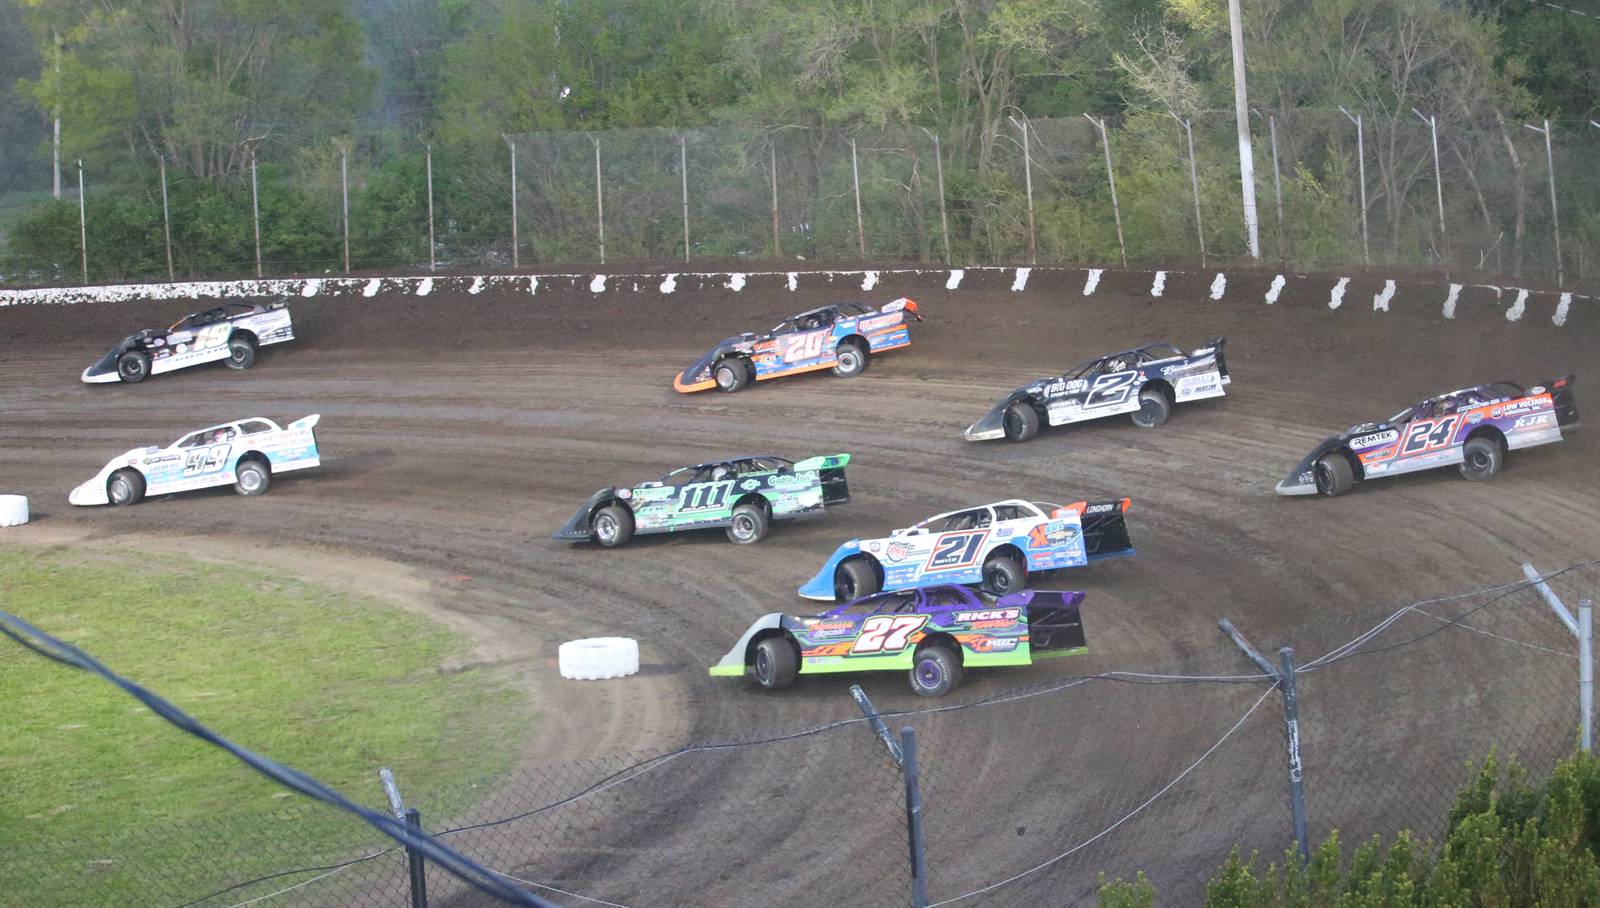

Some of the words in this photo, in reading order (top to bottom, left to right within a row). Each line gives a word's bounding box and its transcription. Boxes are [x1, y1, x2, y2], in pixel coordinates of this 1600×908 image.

[1082, 370, 1138, 410] 2
[1503, 402, 1518, 411] LOW
[1514, 415, 1548, 428] RJR
[1353, 431, 1393, 446] REMTEK
[1403, 415, 1458, 453] 24
[679, 480, 735, 512] 111
[1087, 504, 1114, 513] LONGHORN
[931, 533, 986, 566] 21
[956, 609, 1020, 622] RICK'S
[850, 615, 929, 654] 27
